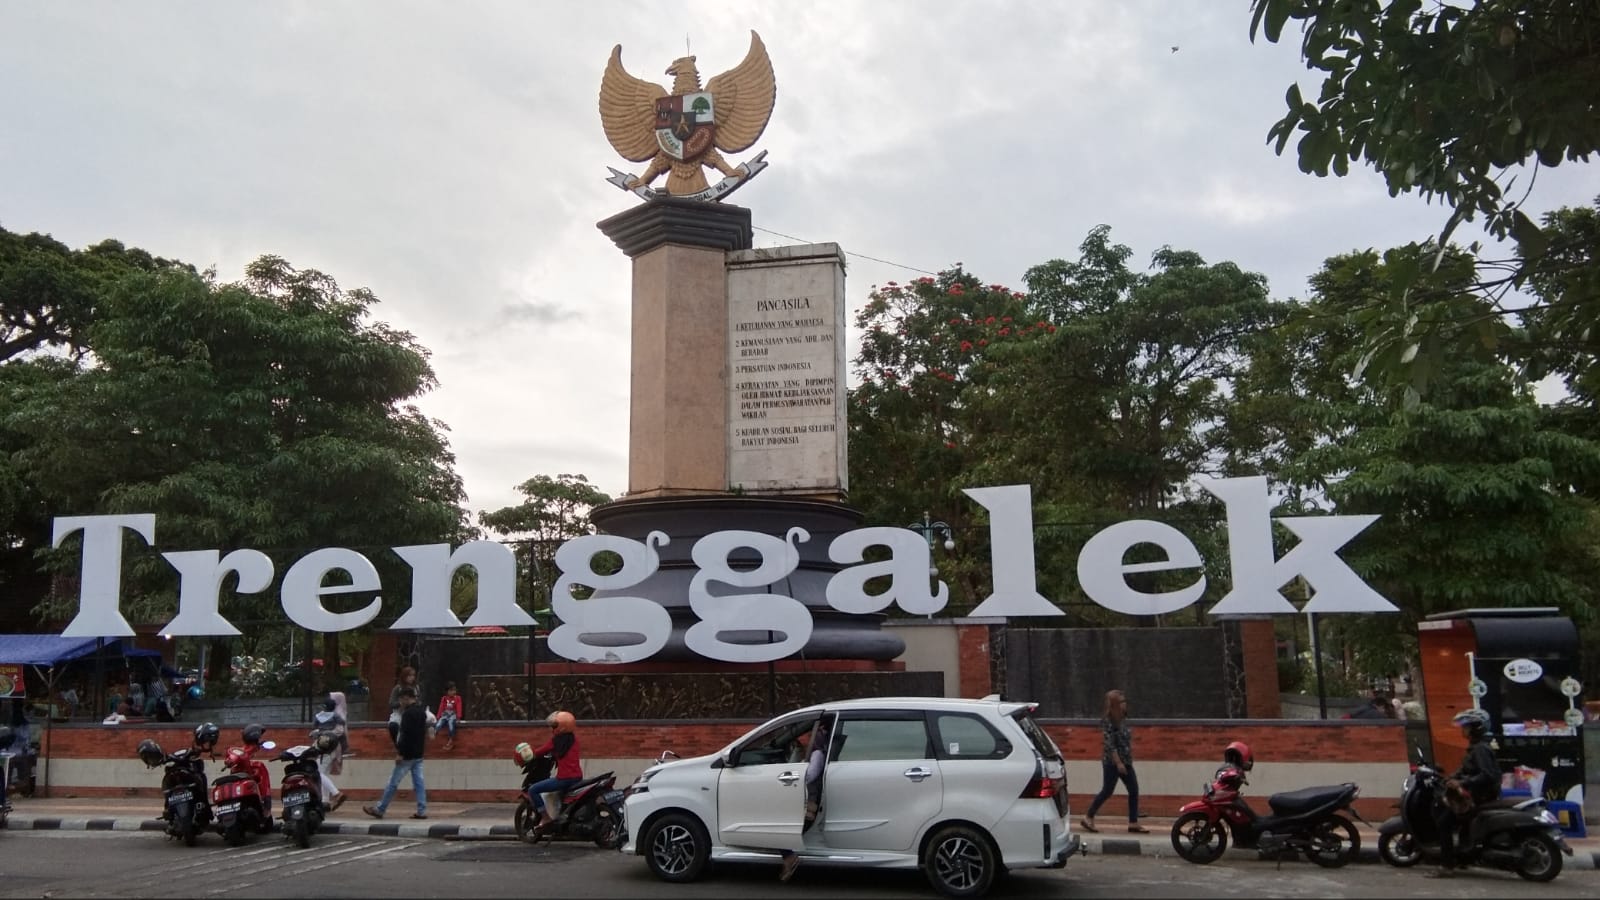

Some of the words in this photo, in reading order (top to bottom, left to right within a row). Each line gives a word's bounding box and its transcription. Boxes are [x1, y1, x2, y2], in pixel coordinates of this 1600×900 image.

[757, 298, 810, 312] PANCASILA
[777, 320, 793, 328] YANG
[785, 336, 802, 345] YANG
[741, 364, 776, 373] PERSATUAN
[777, 362, 811, 371] INDONESIA
[784, 380, 800, 388] YANG
[767, 436, 799, 445] INDONESIA
[51, 475, 1399, 664] Trenggalek
